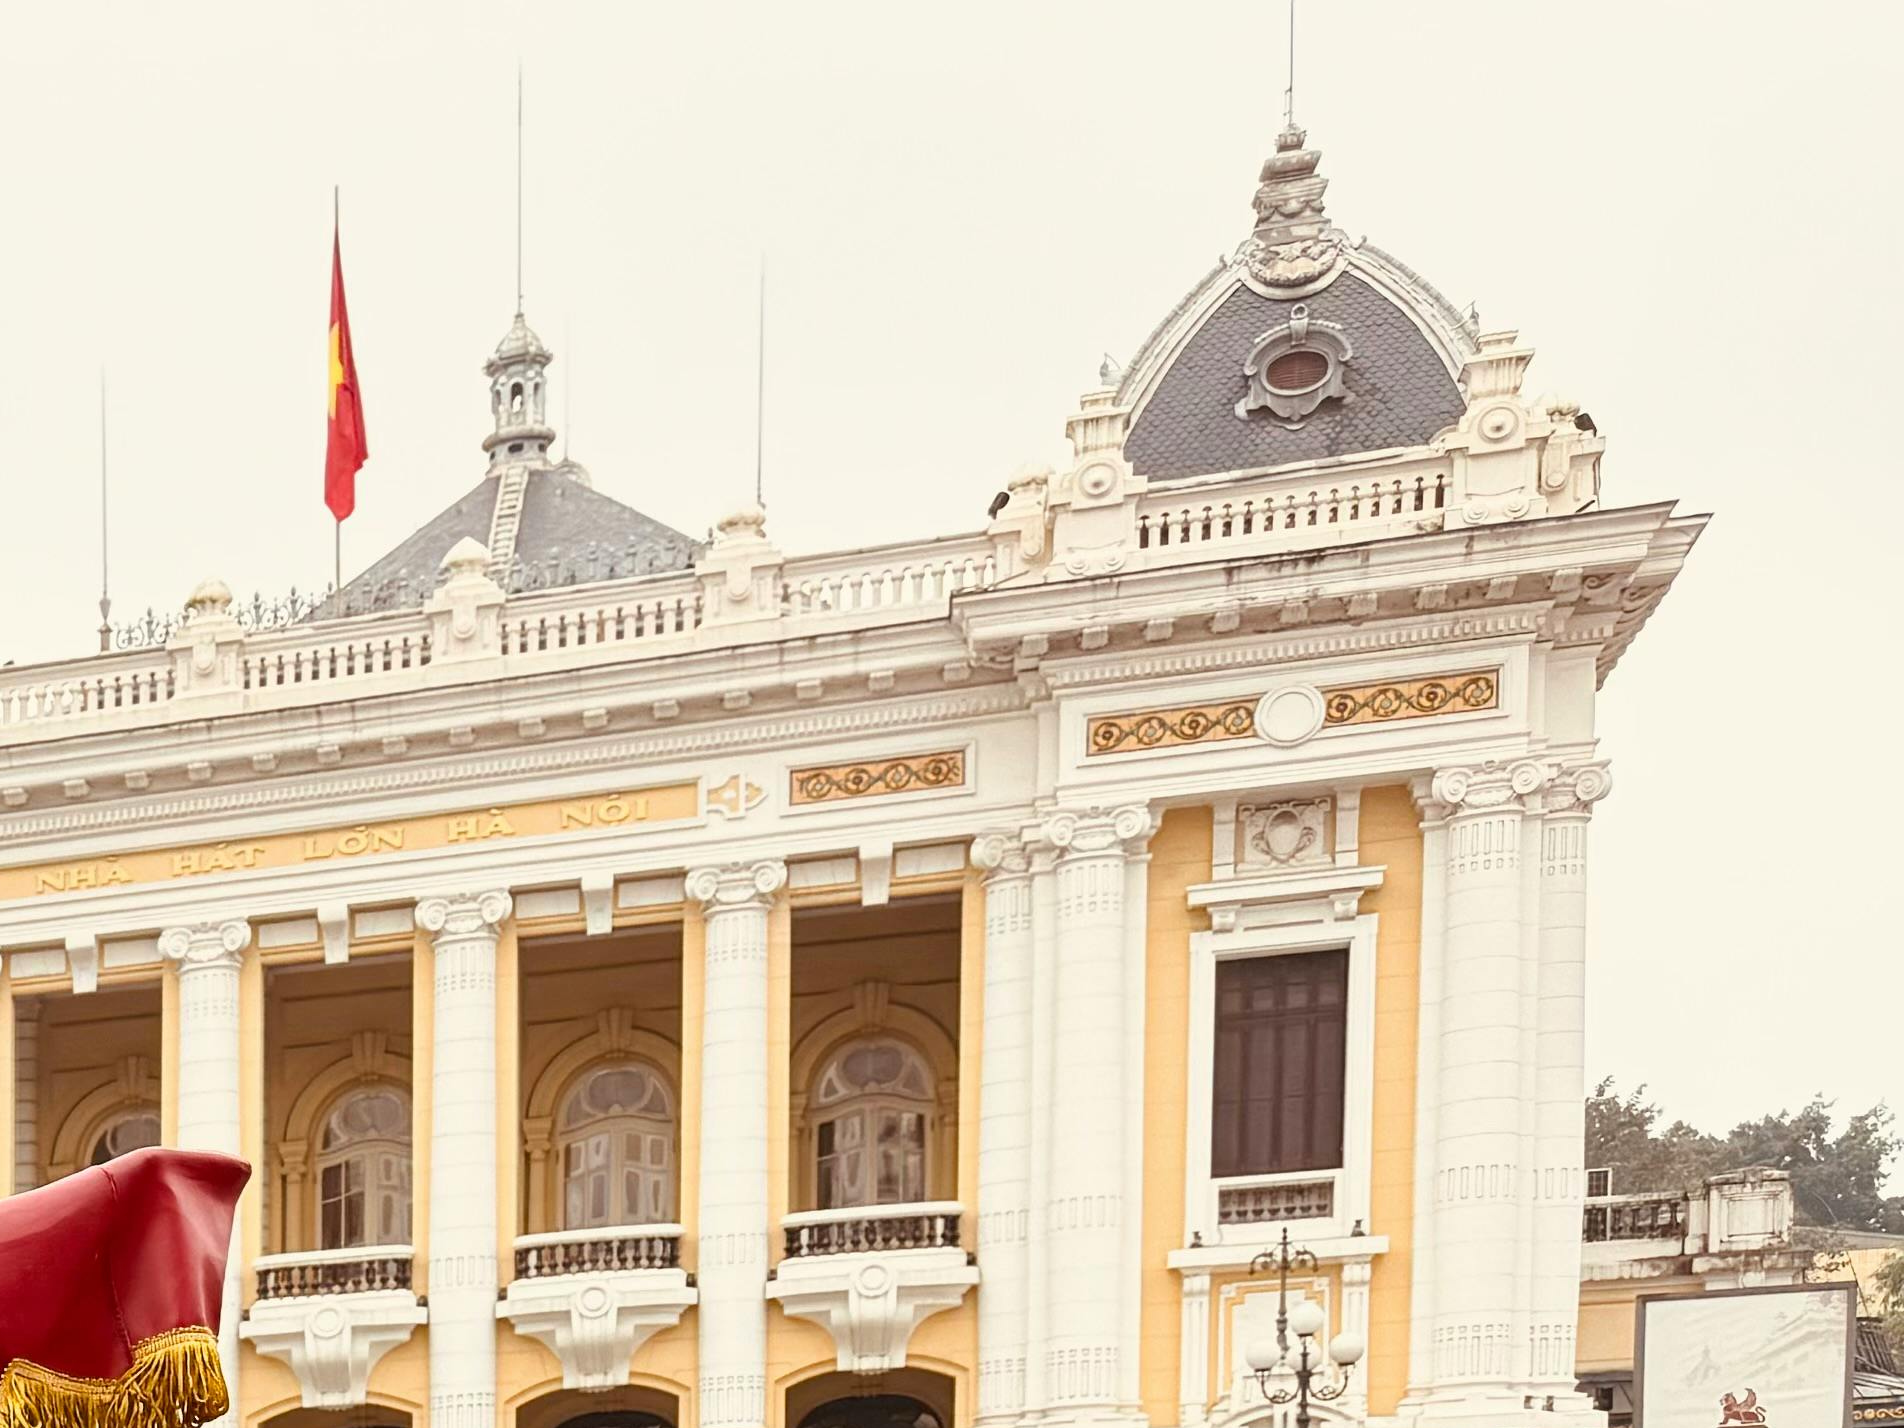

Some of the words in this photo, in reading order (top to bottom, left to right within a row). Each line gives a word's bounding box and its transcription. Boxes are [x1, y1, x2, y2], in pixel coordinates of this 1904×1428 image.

[36, 855, 133, 894] NHÀ
[171, 842, 265, 877] HÁT
[303, 825, 406, 860] LỚN
[447, 809, 517, 843] HÀ
[559, 794, 650, 829] NỘI
